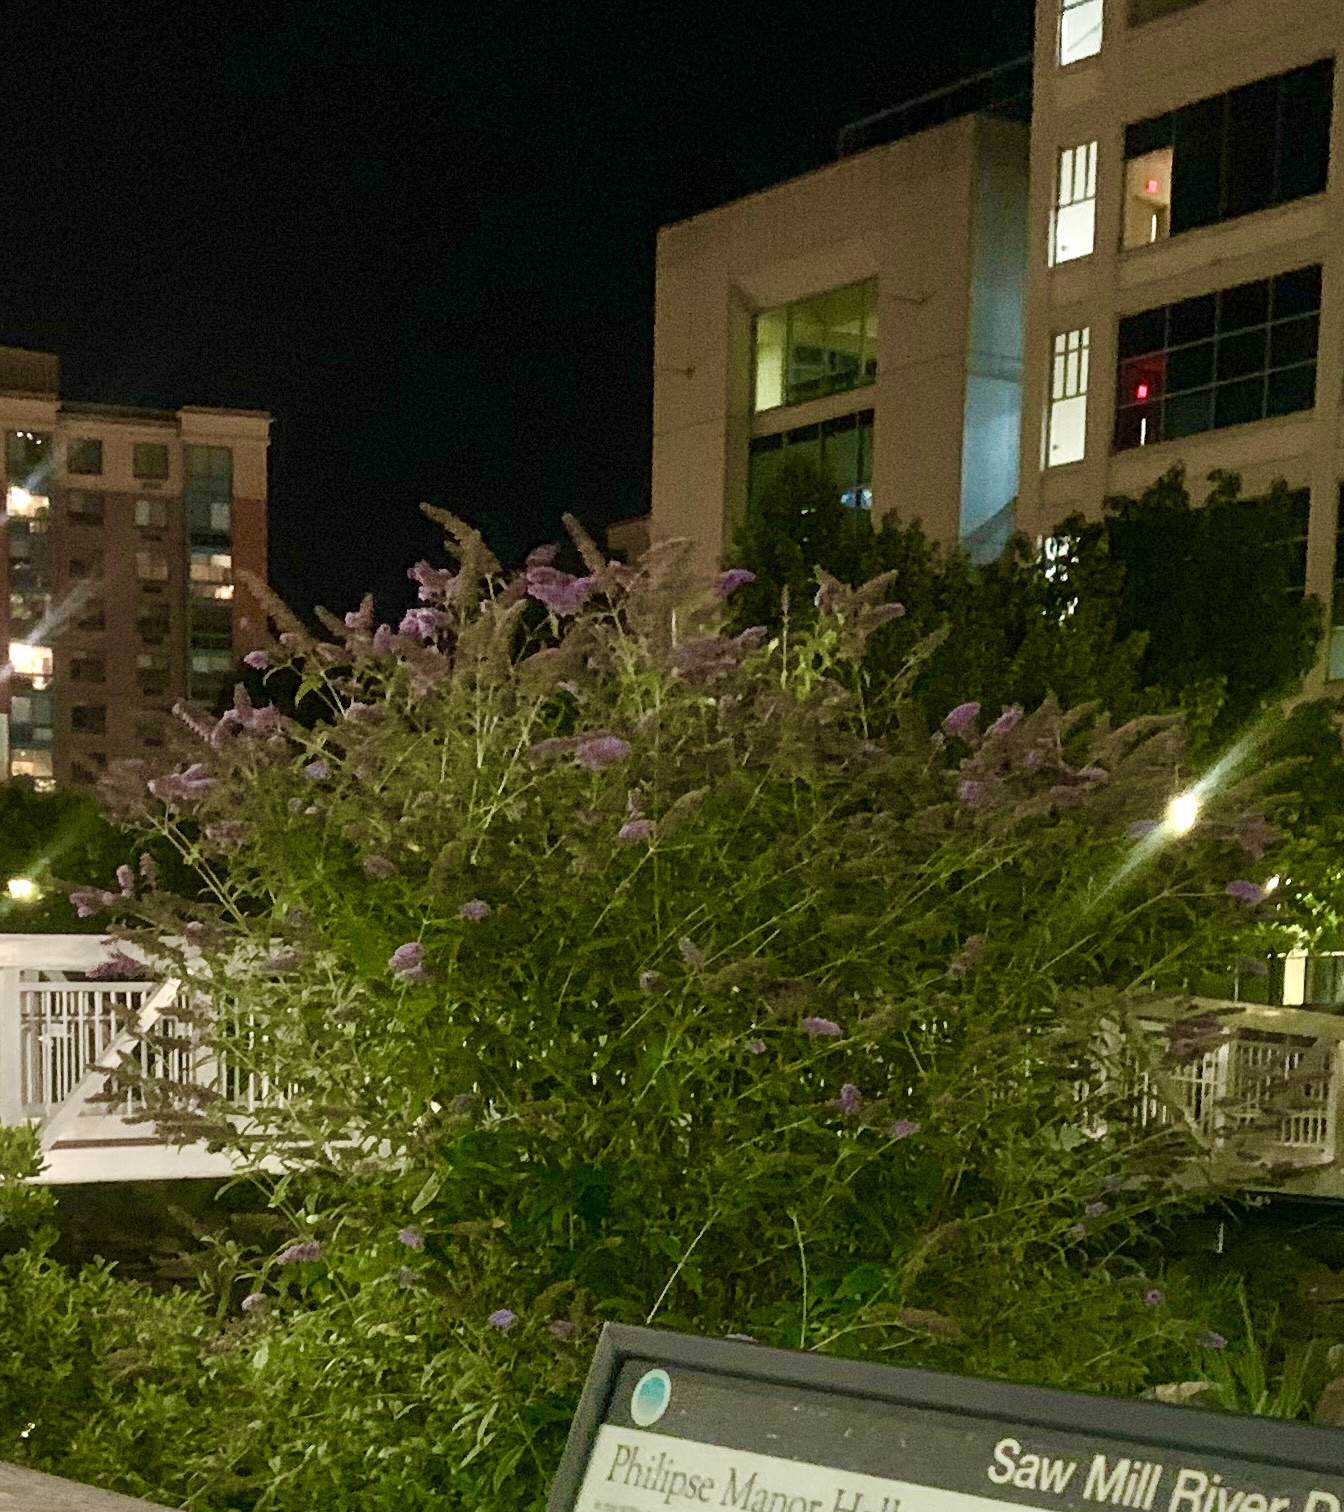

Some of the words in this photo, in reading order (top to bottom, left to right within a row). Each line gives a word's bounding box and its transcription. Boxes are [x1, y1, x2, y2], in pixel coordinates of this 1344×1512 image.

[606, 1443, 715, 1505] Philipse
[987, 1437, 1078, 1494] Saw
[1082, 1454, 1163, 1511] Mill
